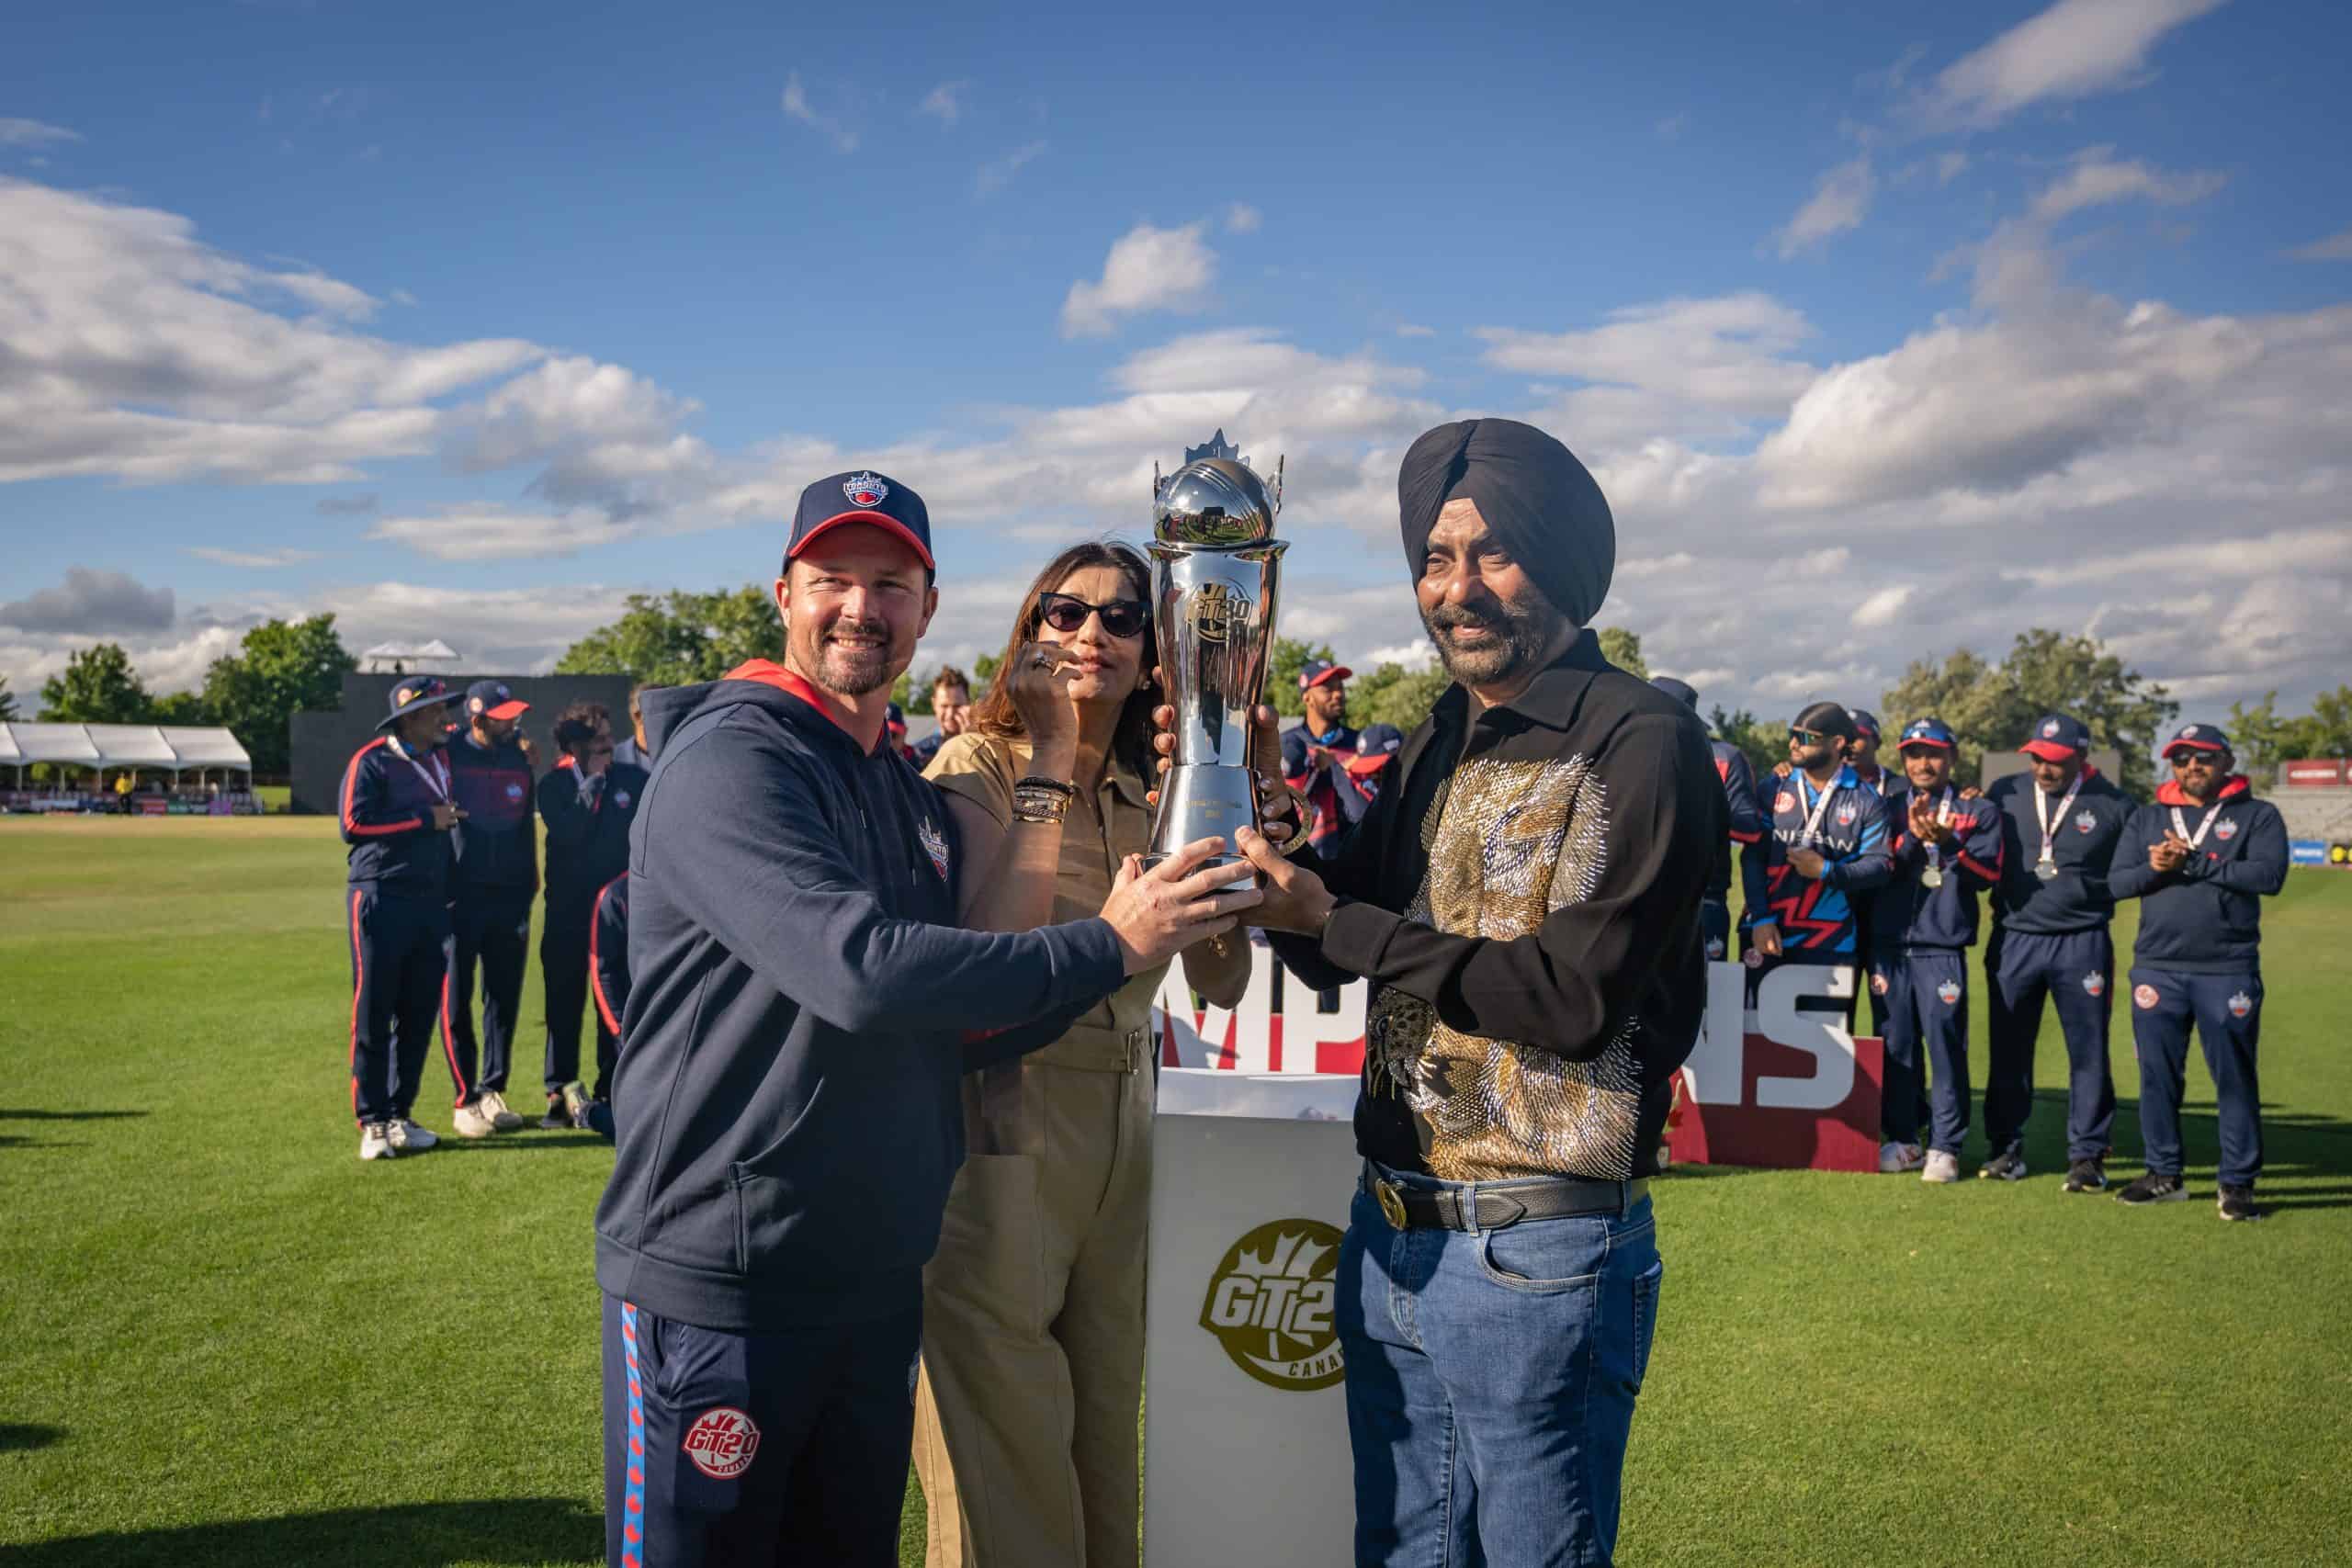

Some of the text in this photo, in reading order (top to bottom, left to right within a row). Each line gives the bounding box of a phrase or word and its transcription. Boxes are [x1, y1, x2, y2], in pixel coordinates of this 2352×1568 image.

[1209, 1275, 1337, 1333] GT2
[1288, 1347, 1345, 1377] CANA
[686, 1428, 759, 1454] GT20
